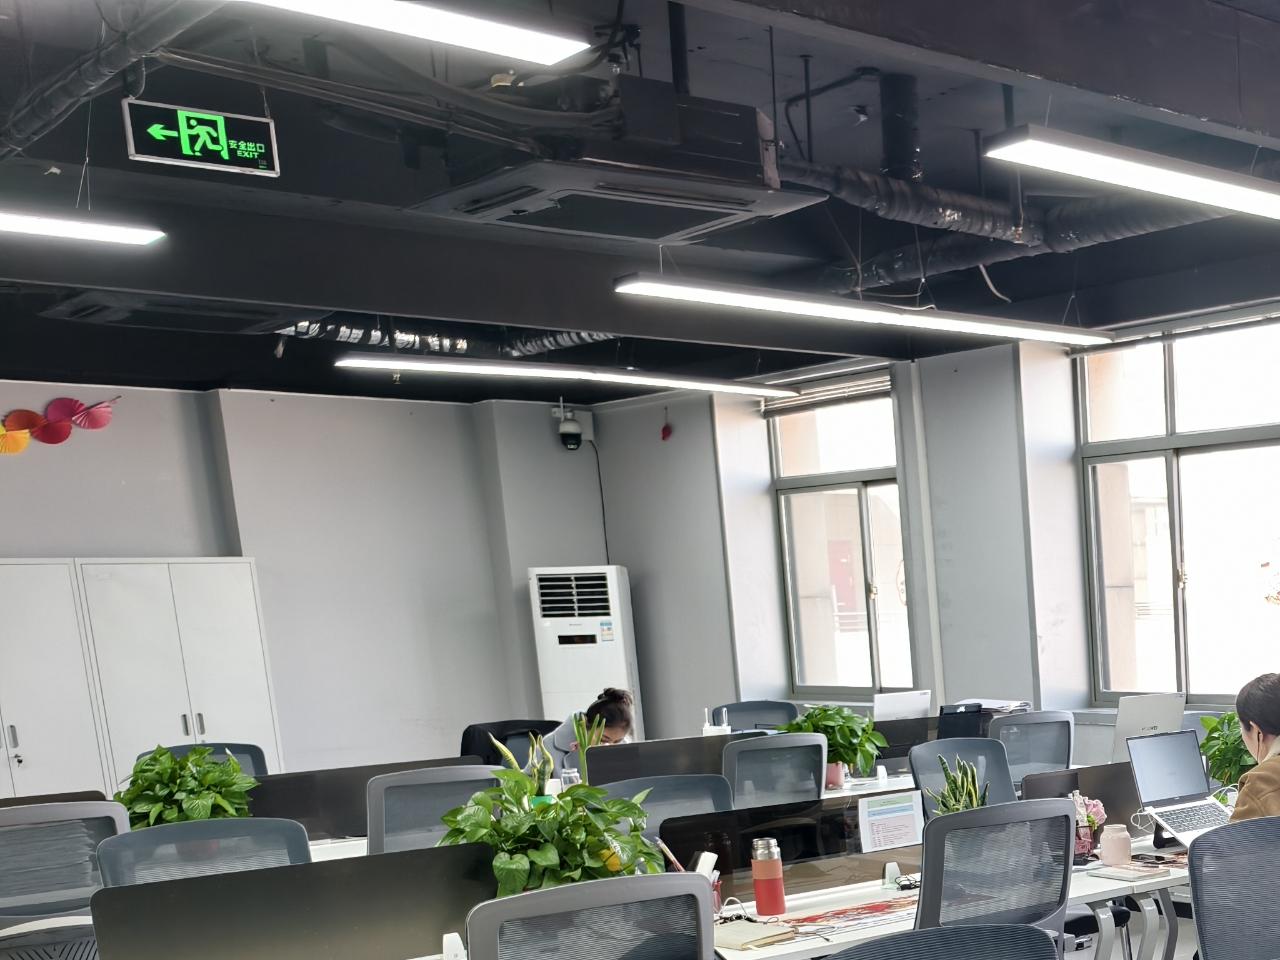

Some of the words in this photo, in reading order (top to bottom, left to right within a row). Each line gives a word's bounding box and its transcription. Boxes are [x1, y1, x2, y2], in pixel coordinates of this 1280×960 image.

[228, 139, 265, 153] 安全出口
[237, 150, 259, 159] EXIT
